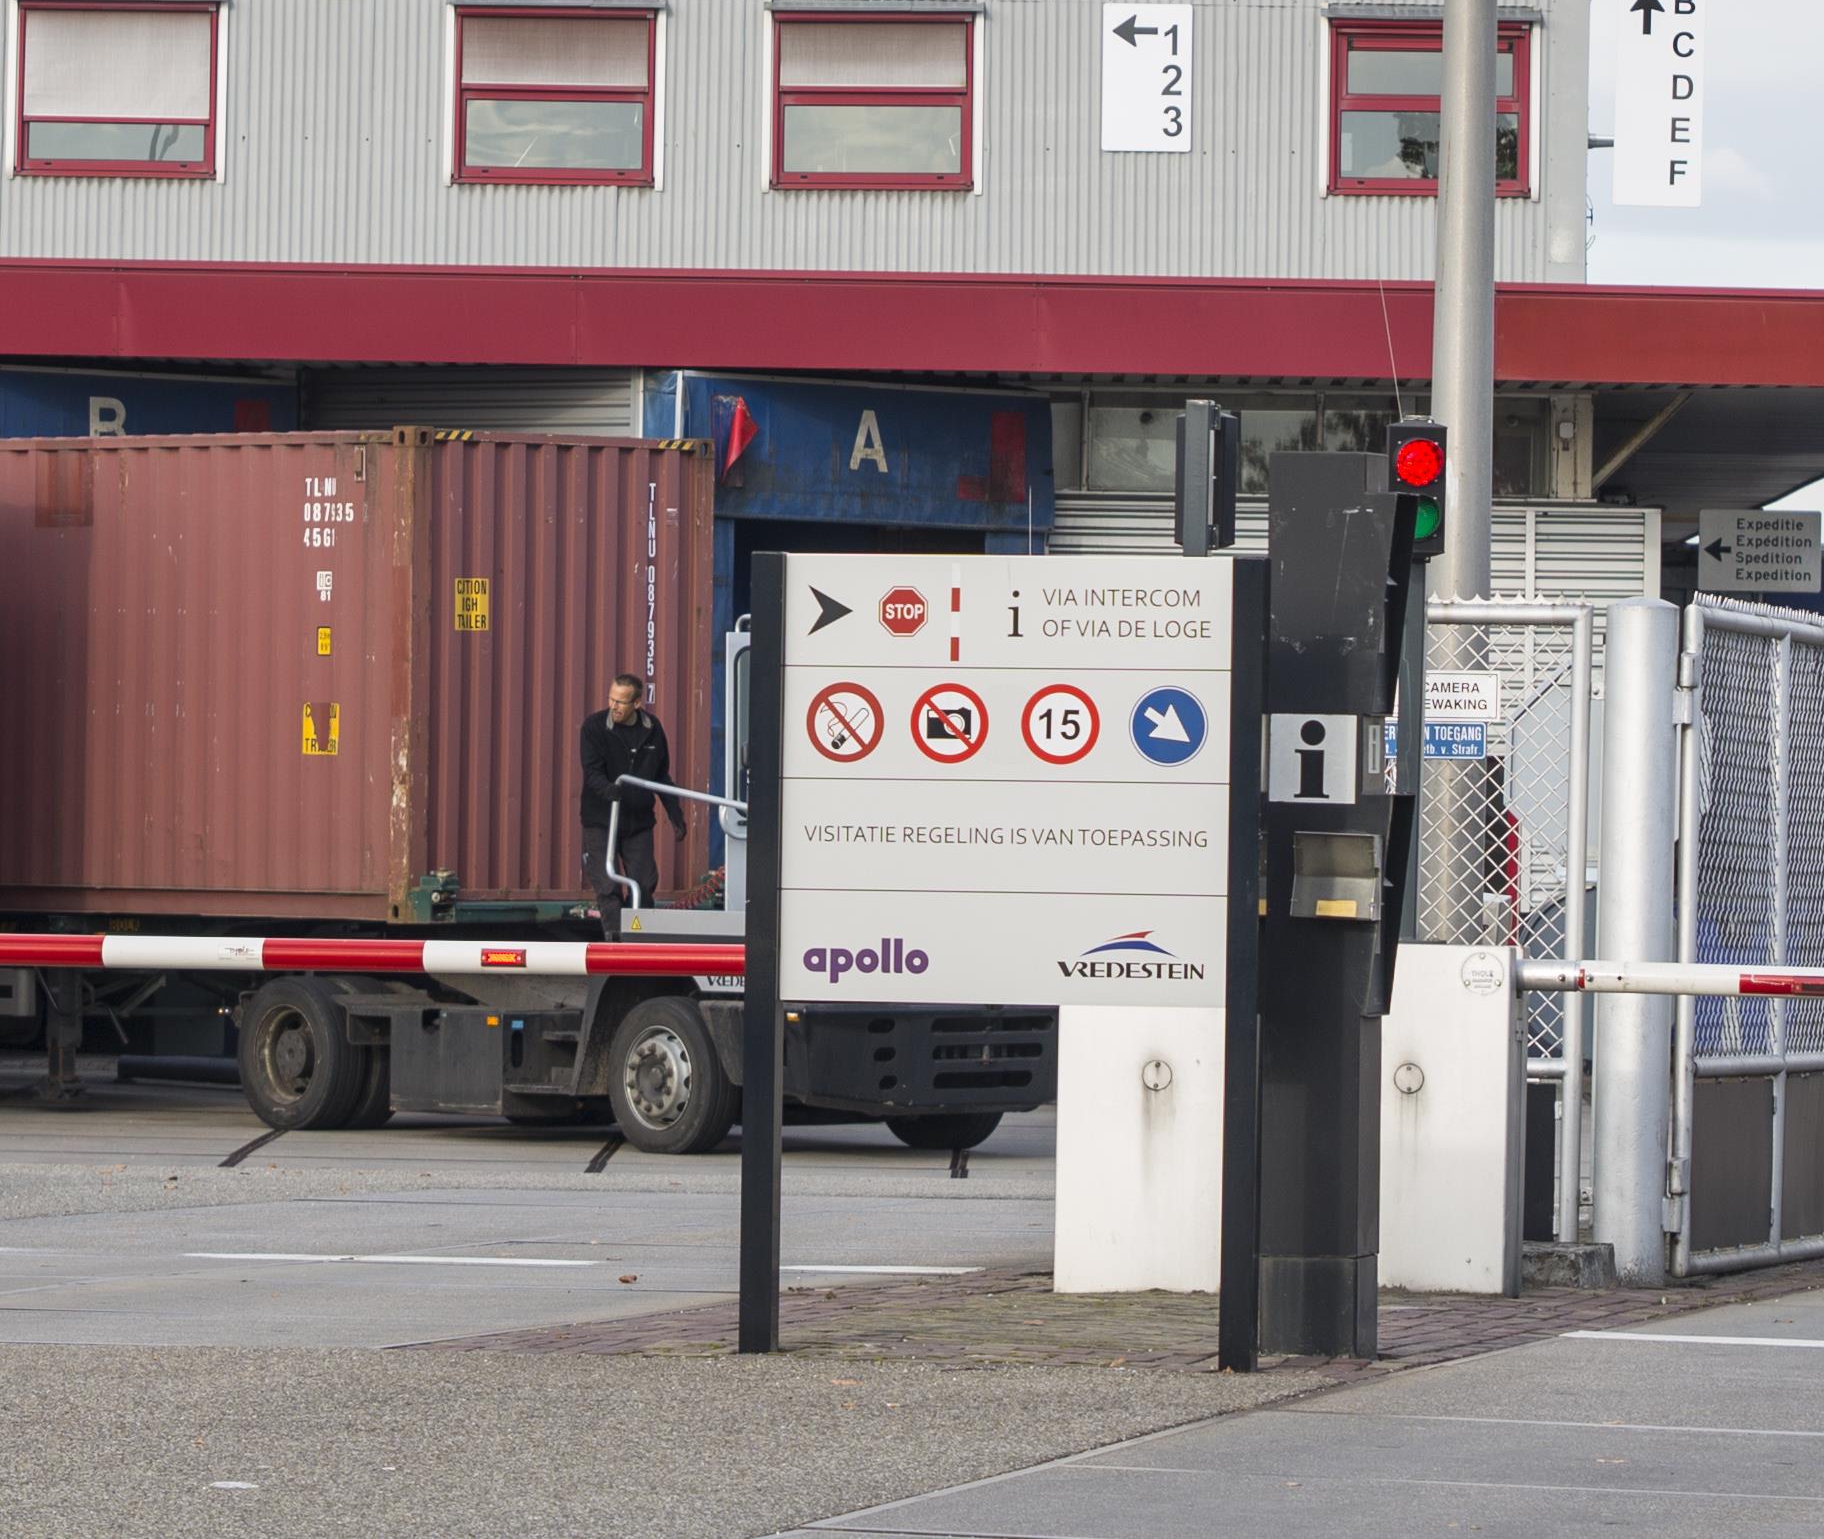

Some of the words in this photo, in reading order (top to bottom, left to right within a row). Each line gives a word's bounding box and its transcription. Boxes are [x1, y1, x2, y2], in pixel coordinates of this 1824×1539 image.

[1163, 24, 1178, 56] 1
[1672, 31, 1695, 58] C
[1161, 64, 1183, 96] 2
[1672, 74, 1694, 100] D
[1162, 105, 1183, 137] 3
[1671, 117, 1691, 143] E
[1669, 160, 1688, 186] F
[849, 409, 889, 473] A
[648, 482, 657, 558] TLNU
[1736, 518, 1804, 532] Expeditie
[1736, 534, 1812, 548] Expédition
[1736, 551, 1803, 565] Spedition
[1736, 568, 1812, 582] Expedition
[1042, 588, 1077, 607] VIA
[1085, 588, 1202, 608] INTERCOM
[646, 565, 656, 677] 087935
[885, 602, 924, 620] STOP
[1042, 620, 1072, 637] OF
[1076, 620, 1110, 637] VIA
[1117, 621, 1146, 638] DE
[1153, 620, 1213, 639] LOGE
[1424, 699, 1488, 710] EWAKING
[1037, 708, 1081, 741] 15
[1435, 726, 1482, 741] TOEGANG
[1452, 744, 1482, 755] Strafr.
[804, 825, 896, 843] VISITATIE
[903, 826, 1004, 845] REGELING
[1010, 828, 1028, 845] IS
[1032, 828, 1073, 846] VAN
[1078, 829, 1208, 848] TOEPASSING
[802, 938, 929, 984] apollo
[1057, 961, 1205, 980] VREDESTEIN
